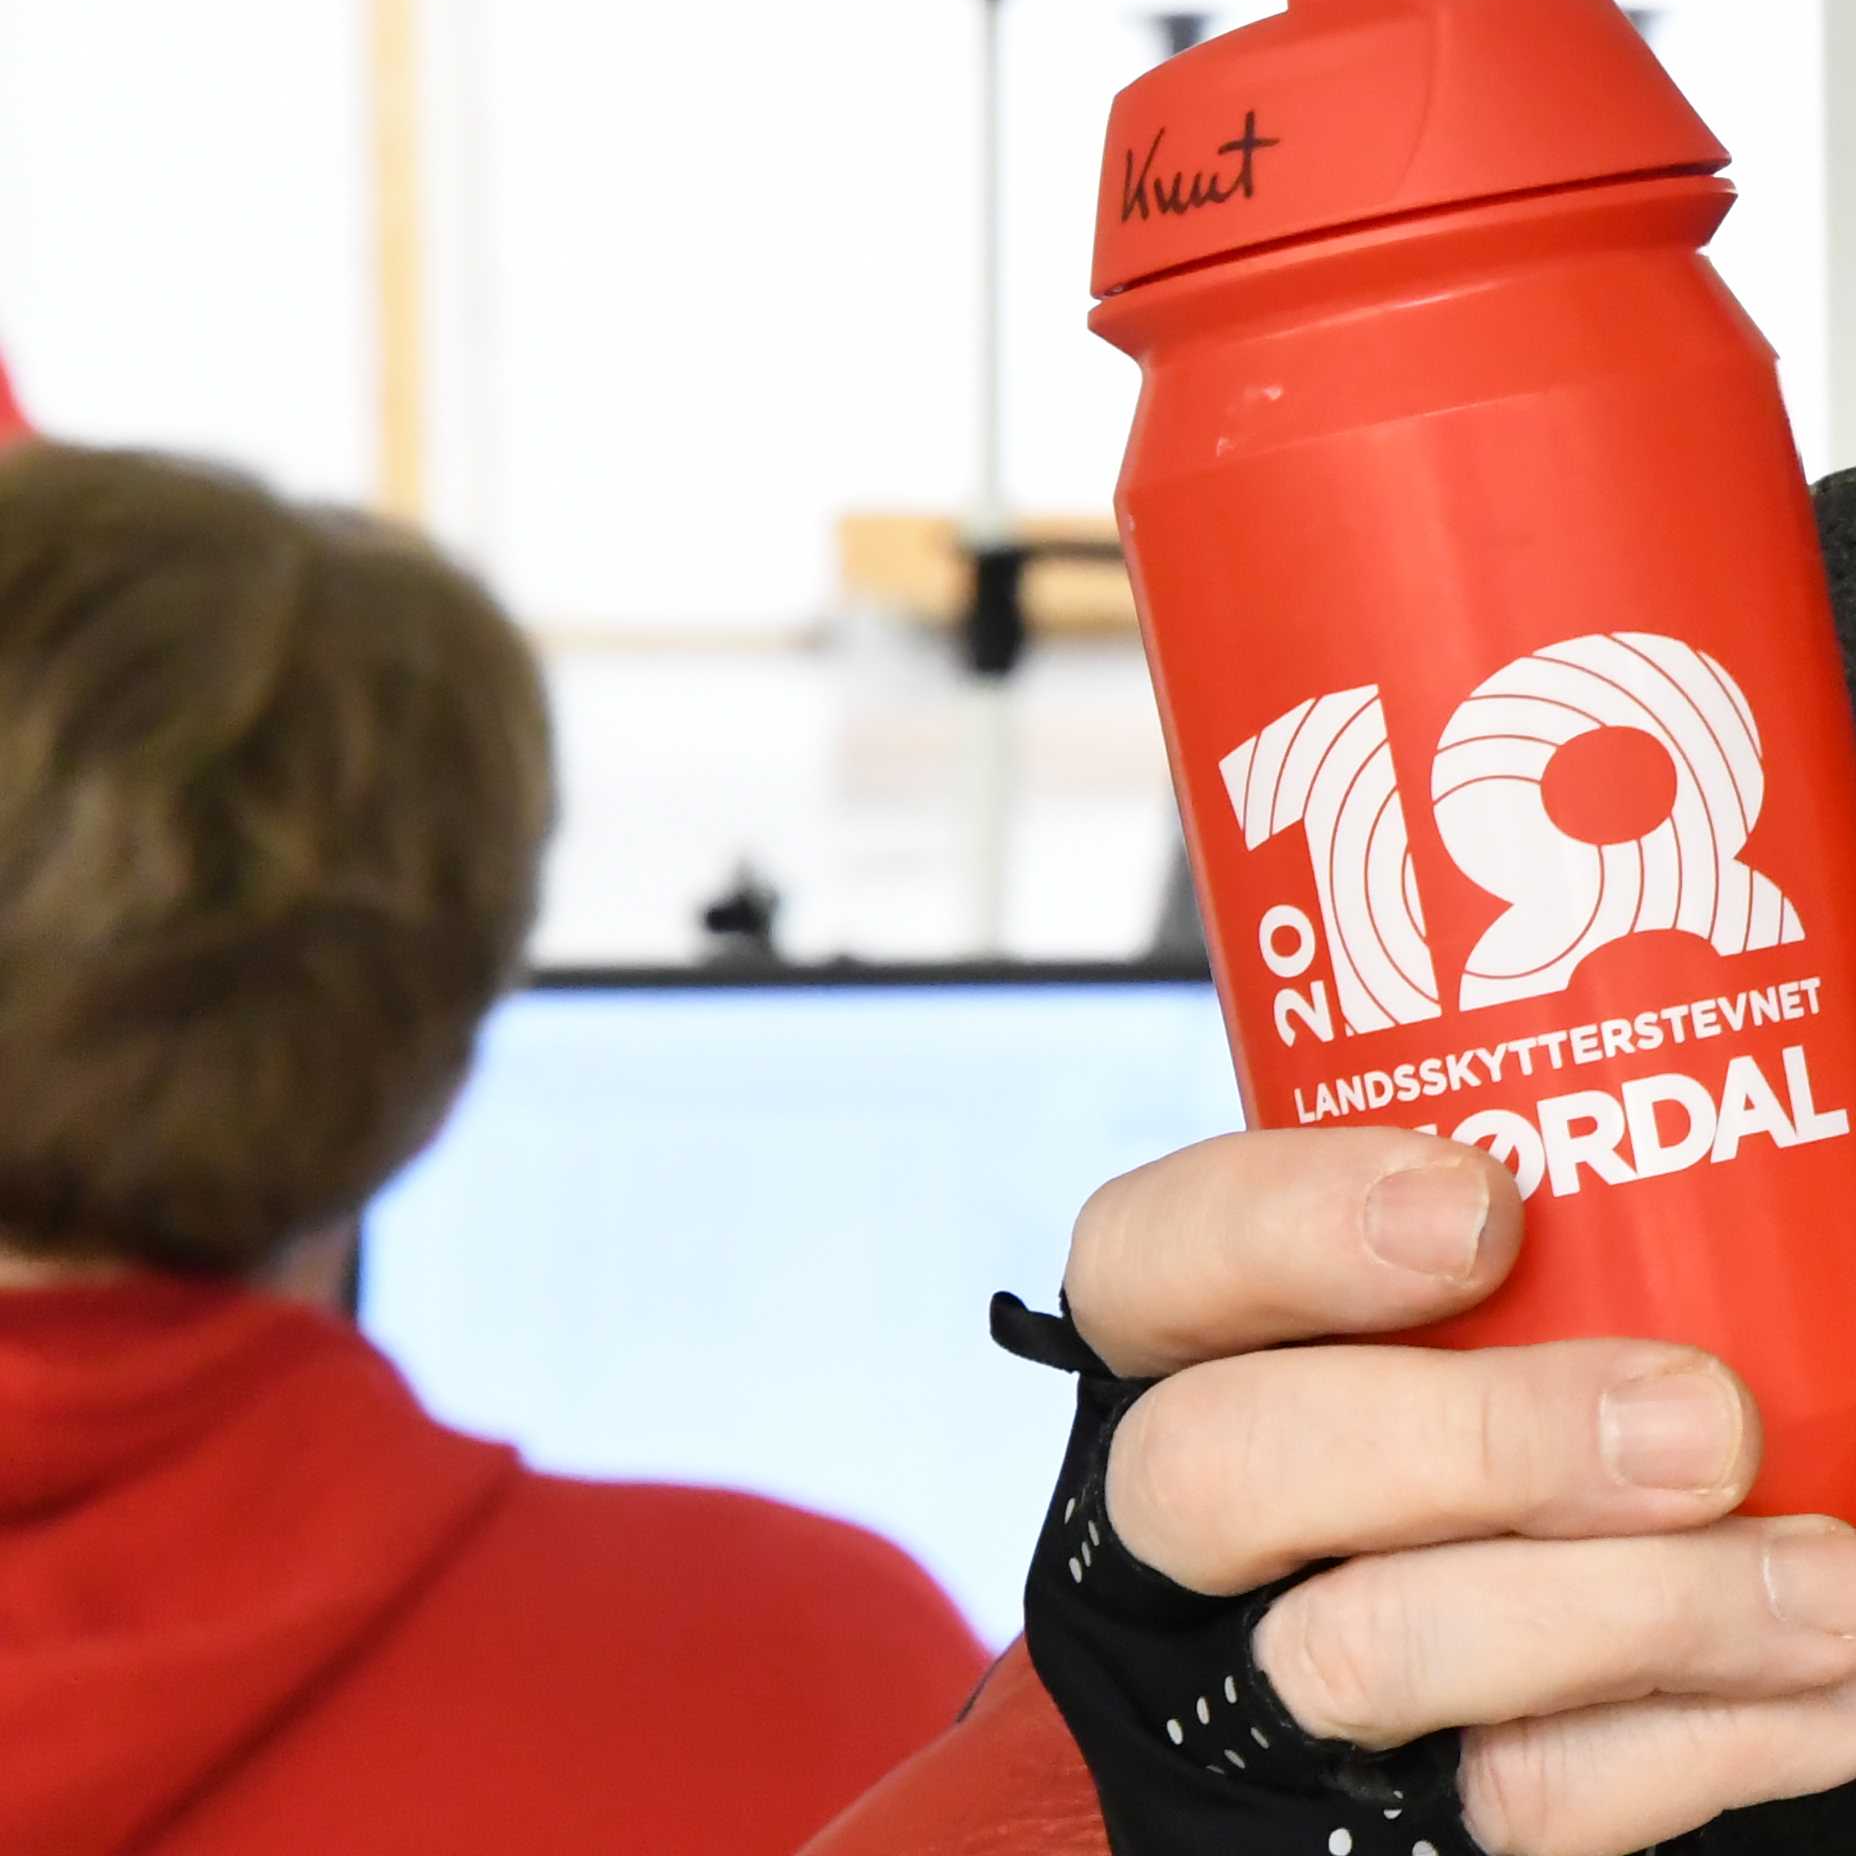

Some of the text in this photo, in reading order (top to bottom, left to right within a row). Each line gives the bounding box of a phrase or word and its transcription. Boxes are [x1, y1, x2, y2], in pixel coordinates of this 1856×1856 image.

[1120, 109, 1281, 222] Knut
[1294, 977, 1824, 1124] LANDSSKYTTERSTEVNET
[1408, 1044, 1850, 1200] ØRDAL
